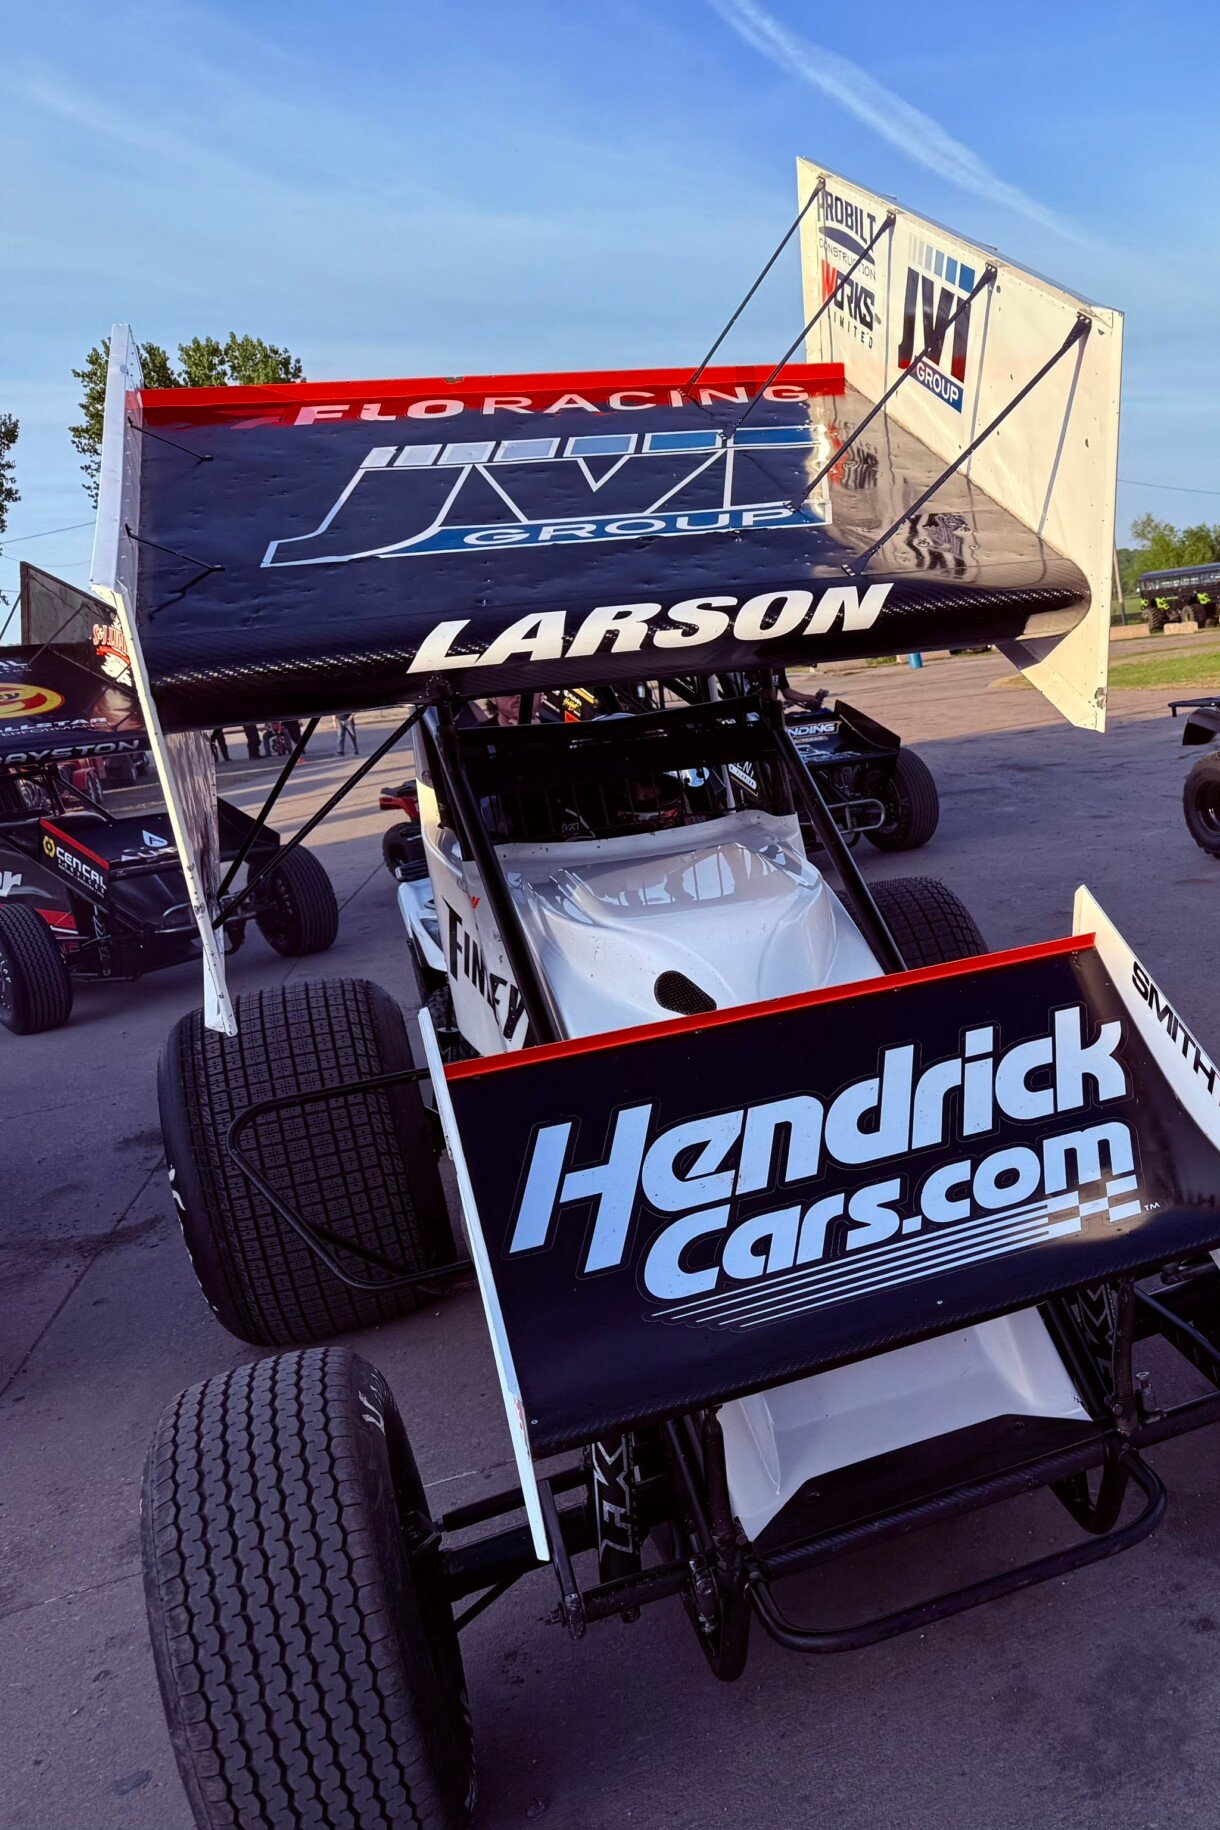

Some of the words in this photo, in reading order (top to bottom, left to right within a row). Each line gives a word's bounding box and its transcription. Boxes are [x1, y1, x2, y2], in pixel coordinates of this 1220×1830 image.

[821, 258, 876, 332] WORKS
[830, 311, 873, 349] IMITED
[293, 384, 810, 426] FLORACING
[916, 362, 959, 403] GROUP
[462, 507, 797, 546] GROUP
[407, 582, 894, 675] LARSON
[1132, 960, 1216, 1095] SMITH
[509, 1004, 1127, 1274] Hendrick
[643, 1120, 1137, 1300] Cars.com
